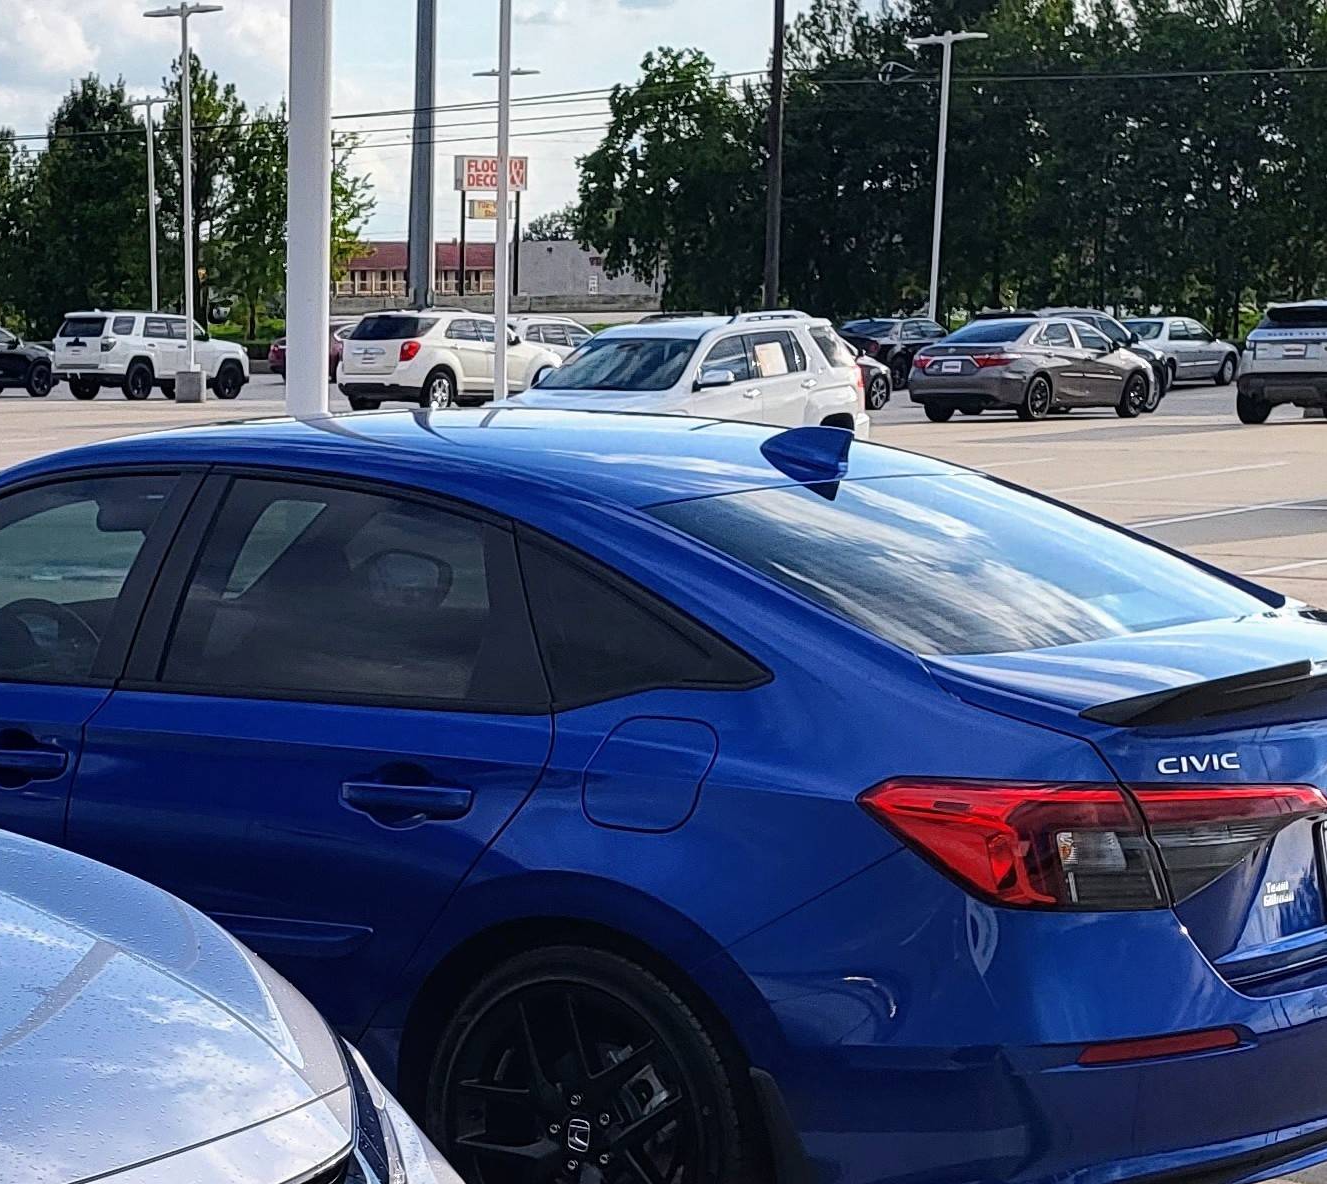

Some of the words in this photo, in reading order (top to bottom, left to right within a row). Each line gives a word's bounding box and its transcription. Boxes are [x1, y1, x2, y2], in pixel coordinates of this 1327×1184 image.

[467, 160, 500, 173] FLOO
[467, 174, 500, 187] DECO
[1157, 752, 1241, 774] CIVIC
